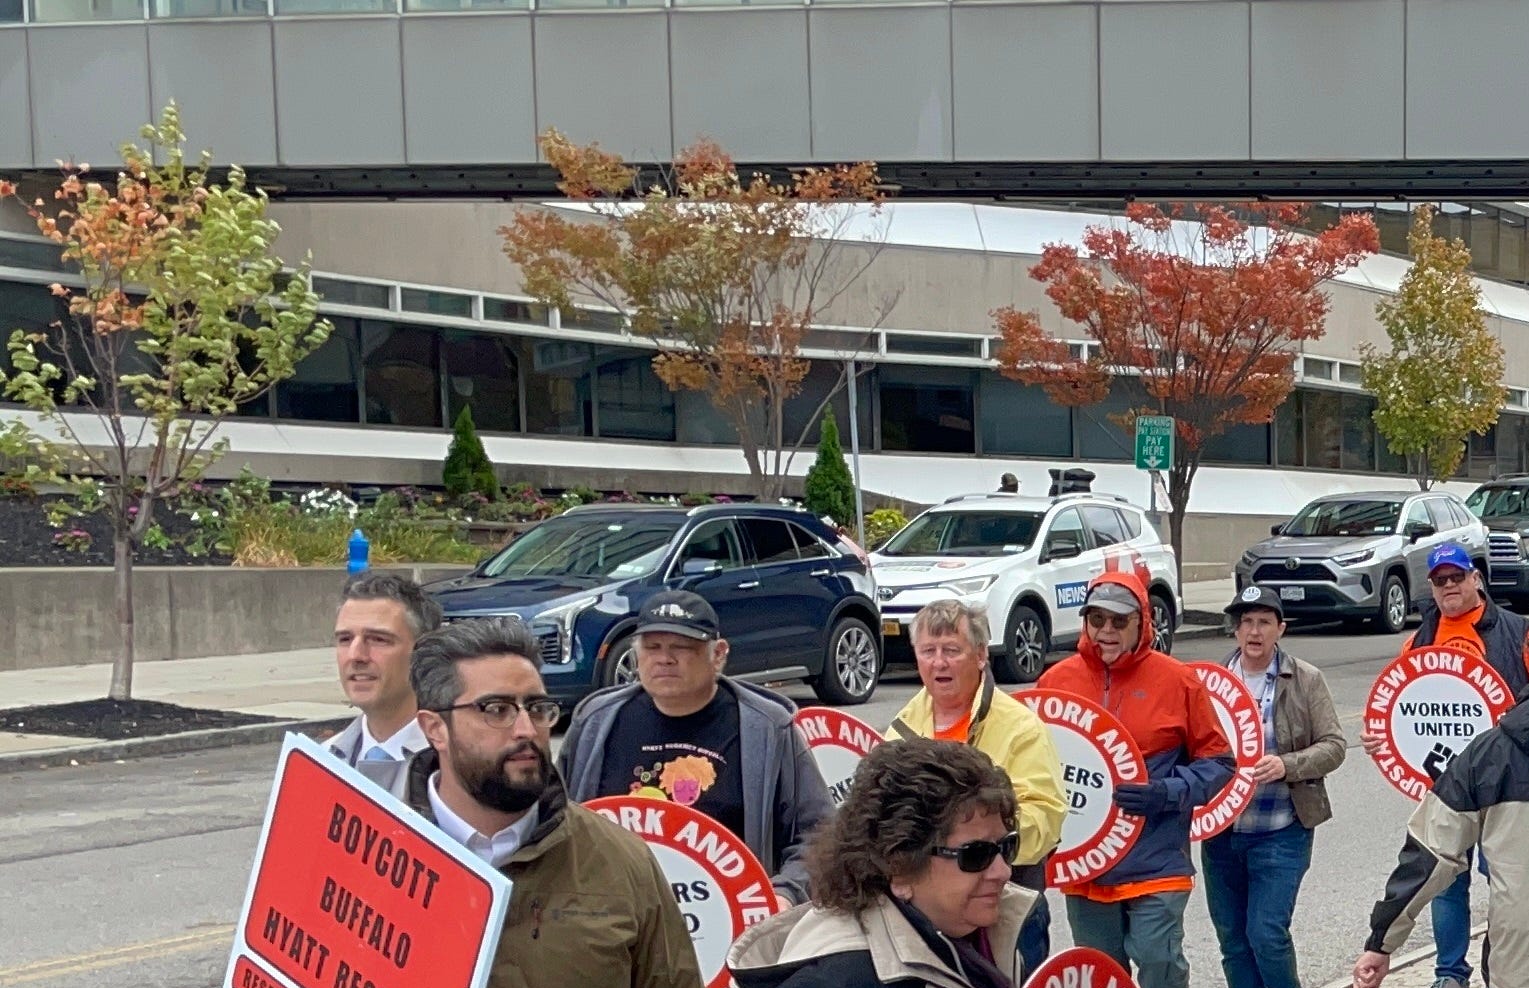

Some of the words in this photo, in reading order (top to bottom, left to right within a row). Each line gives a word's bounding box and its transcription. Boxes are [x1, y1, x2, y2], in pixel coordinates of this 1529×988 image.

[1142, 445, 1165, 456] HERE
[1145, 435, 1162, 446] PAY
[1057, 584, 1087, 605] NEWS
[1371, 663, 1408, 714] NEW
[1408, 652, 1465, 674] YORK
[1467, 665, 1506, 705] AND
[1235, 707, 1258, 758] AND
[1399, 702, 1483, 717] WORKERS
[1414, 722, 1475, 737] UNITED
[838, 720, 881, 753] AN
[1095, 728, 1138, 781] AND
[1189, 766, 1256, 838] VERMON
[326, 802, 440, 910] BOYCOTT
[673, 820, 745, 878] AND
[263, 906, 331, 980] HYATT
[319, 876, 412, 969] BUFFALO
